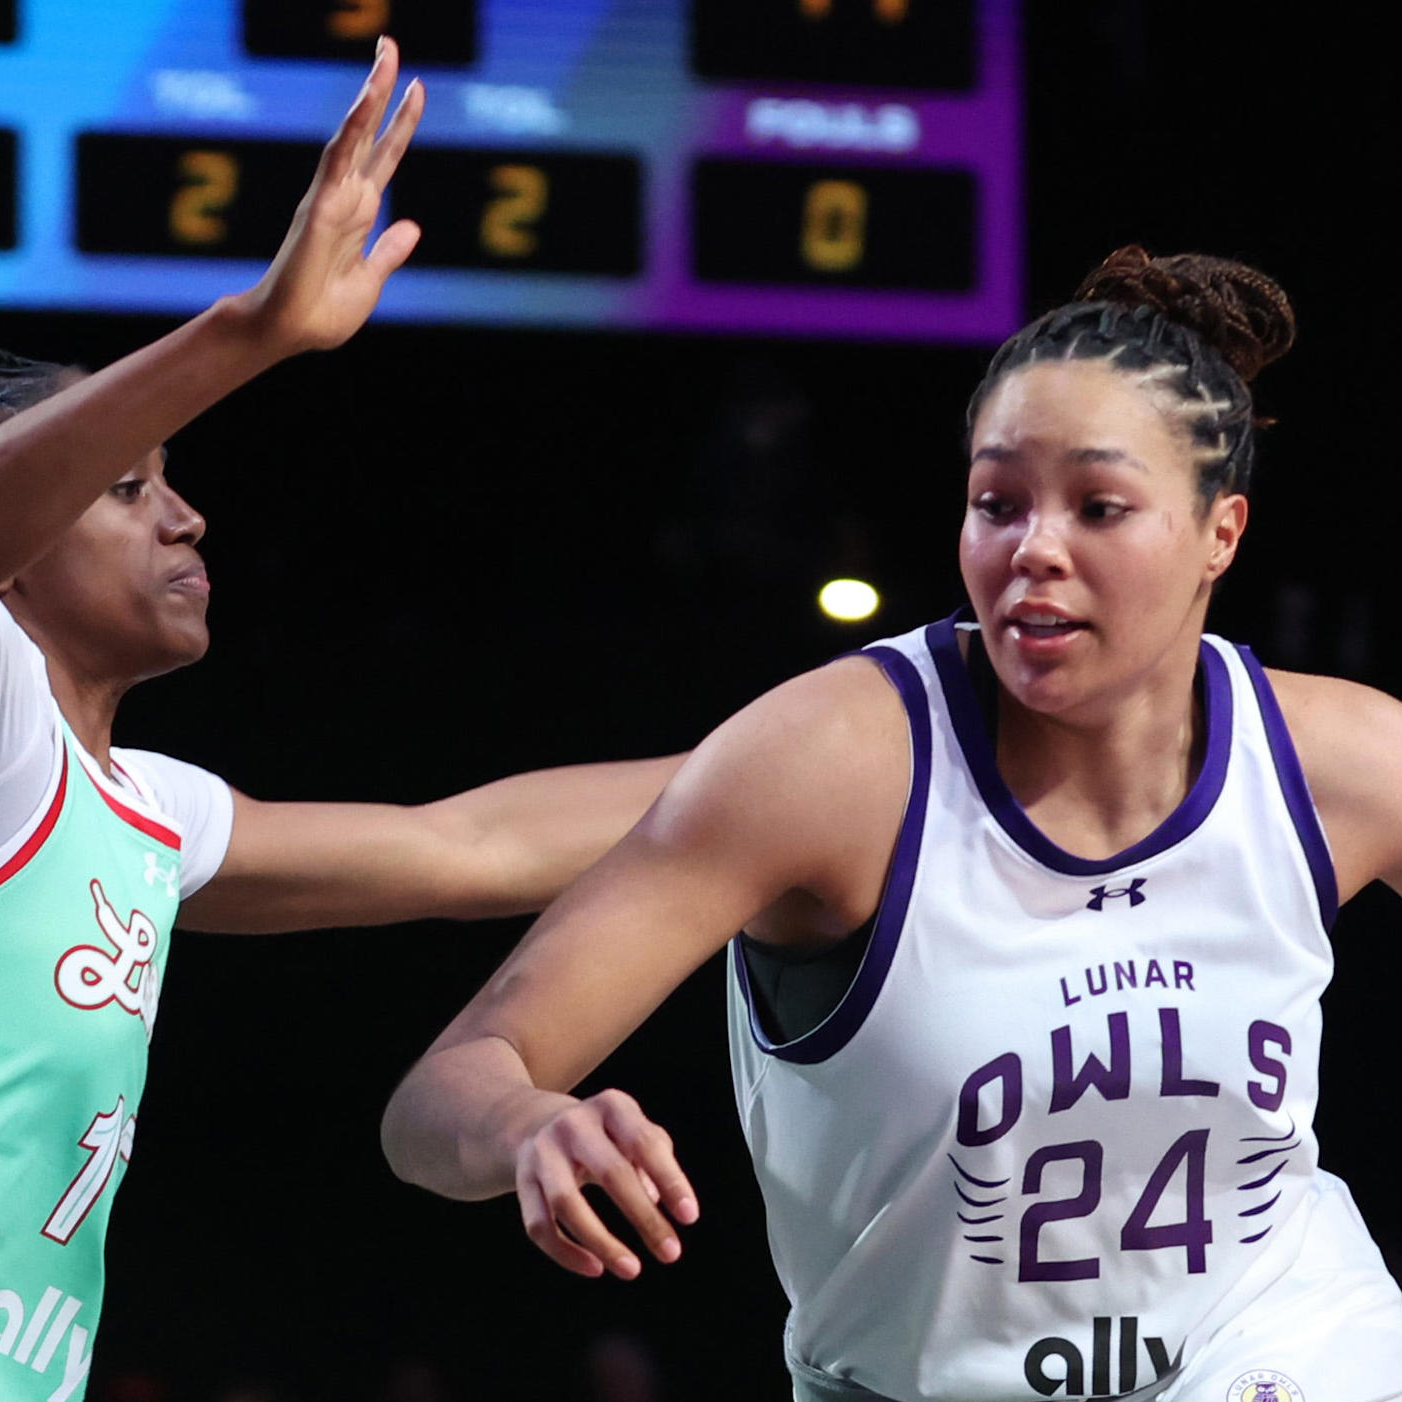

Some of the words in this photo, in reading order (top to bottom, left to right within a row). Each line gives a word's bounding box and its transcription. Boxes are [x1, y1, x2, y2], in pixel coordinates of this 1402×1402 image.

[167, 148, 241, 246] 2
[479, 160, 550, 261] 2
[800, 177, 869, 272] 0
[1060, 958, 1196, 1007] LUNAR
[956, 1006, 1293, 1148] OWLS
[1018, 1128, 1213, 1283] 24
